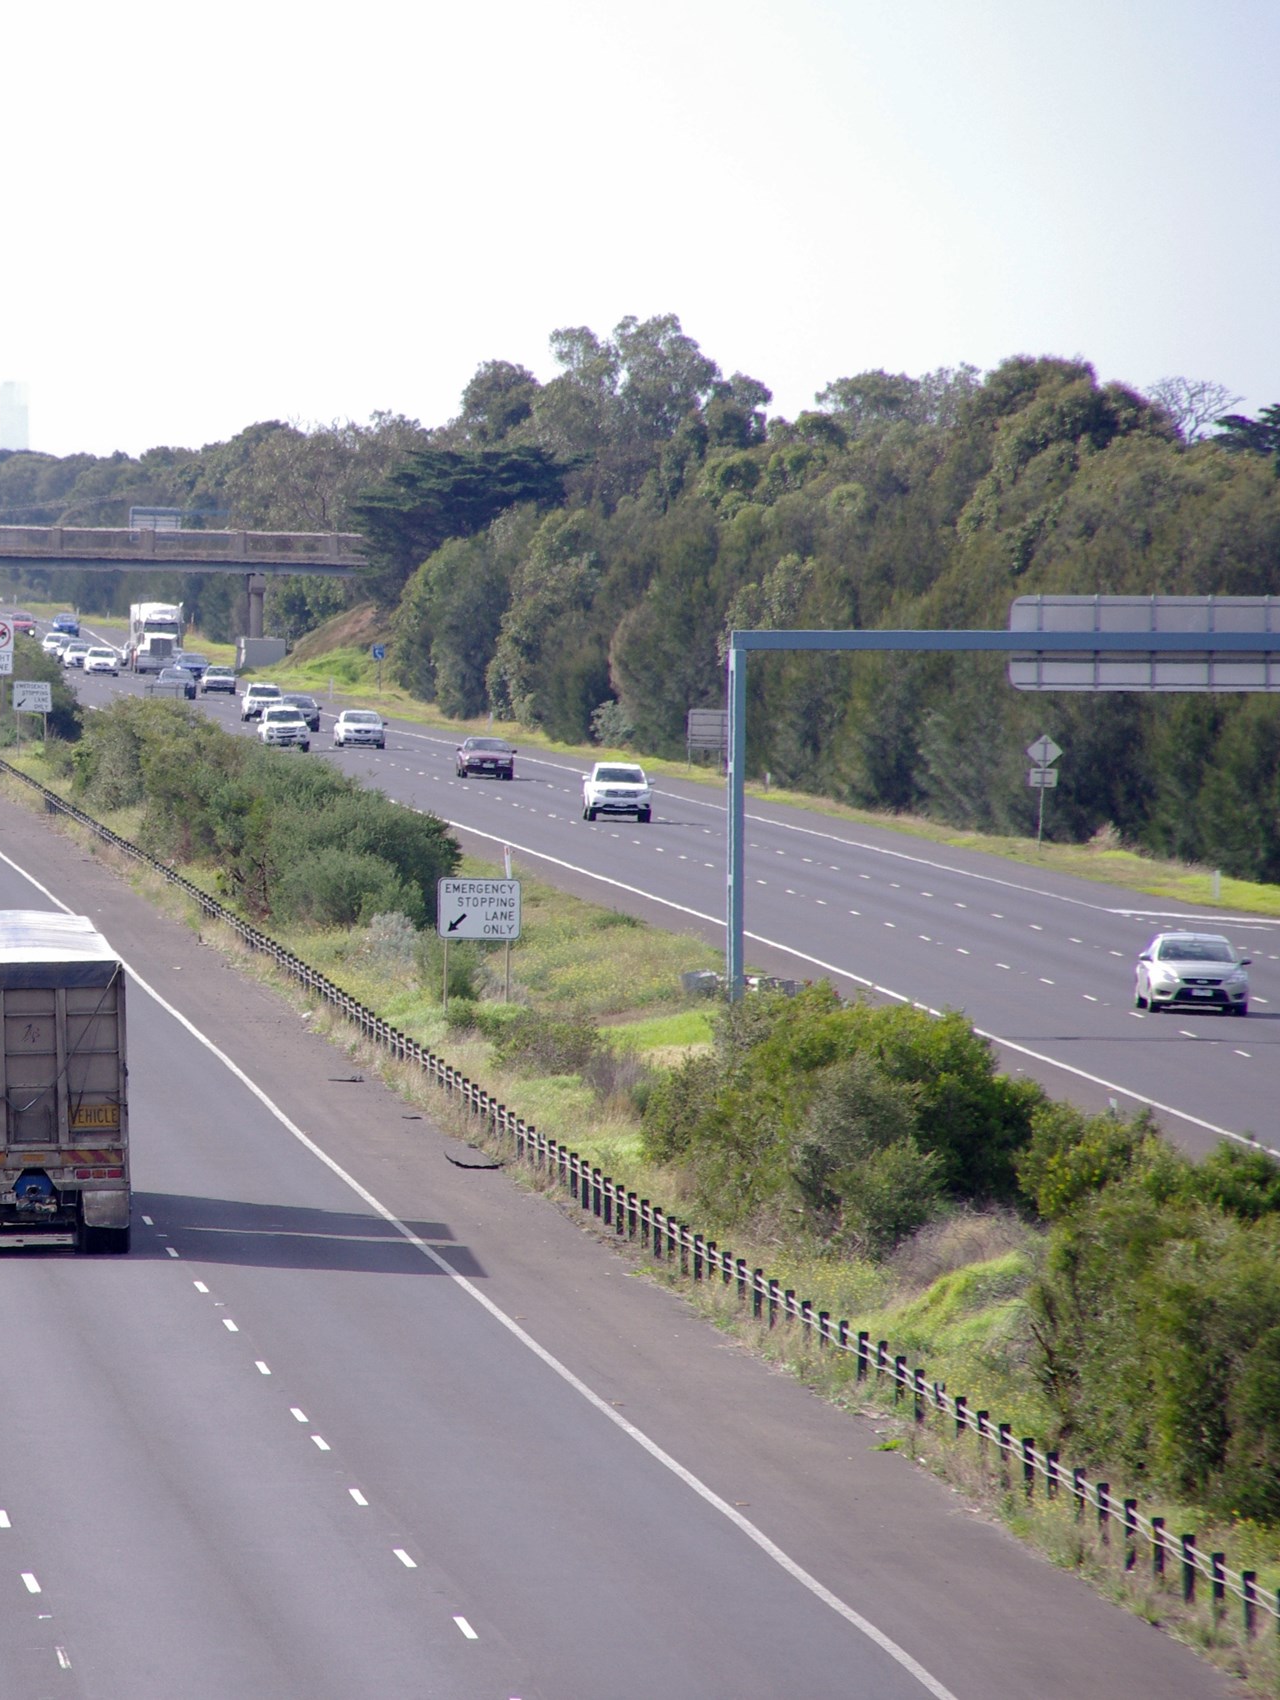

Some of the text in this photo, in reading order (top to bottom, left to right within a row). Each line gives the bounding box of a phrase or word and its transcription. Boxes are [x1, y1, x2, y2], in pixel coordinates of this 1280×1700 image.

[445, 884, 515, 894] EMERGENCY
[458, 897, 515, 907] STOPPING
[485, 911, 515, 921] LANE
[483, 925, 514, 934] ONLY
